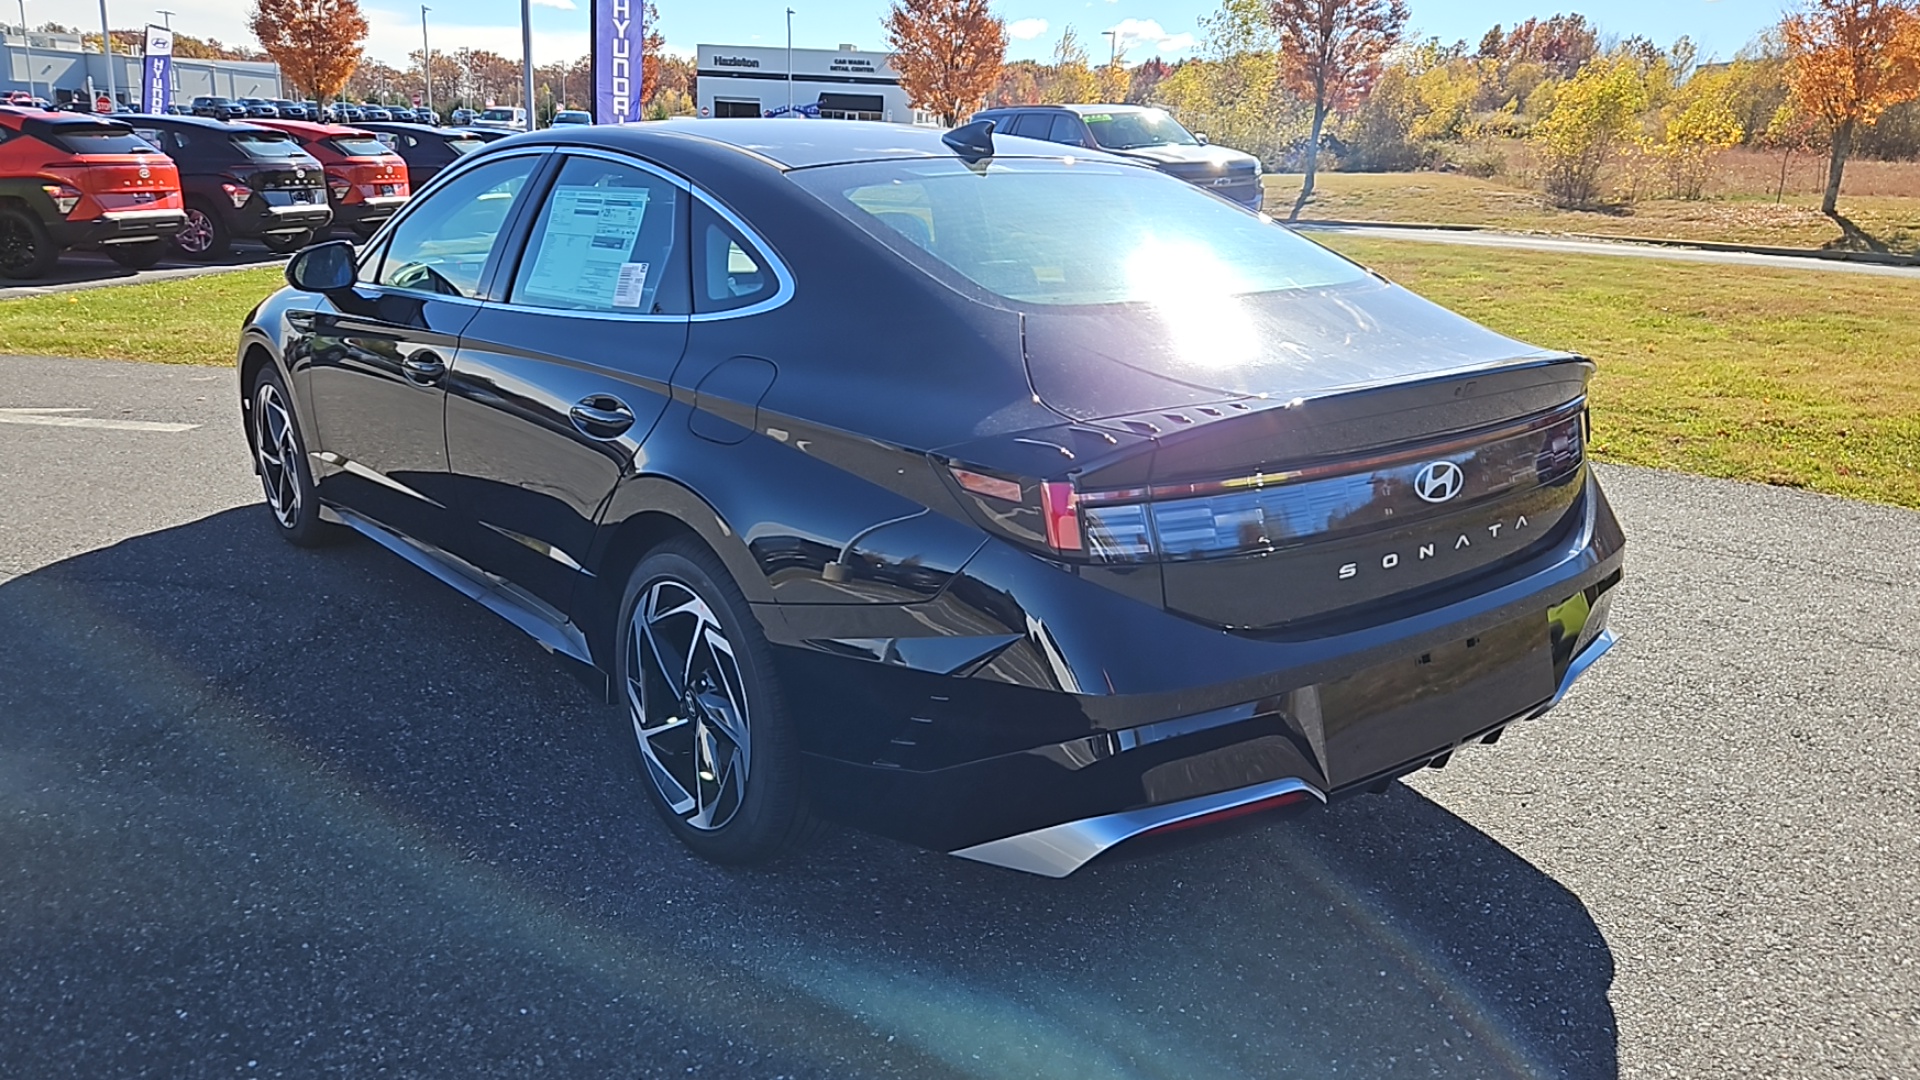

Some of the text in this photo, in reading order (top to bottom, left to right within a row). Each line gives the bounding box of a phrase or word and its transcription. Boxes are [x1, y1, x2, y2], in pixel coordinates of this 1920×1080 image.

[152, 58, 164, 114] HYUNDA
[713, 55, 760, 68] Hazleton
[1338, 515, 1529, 580] SONATA
